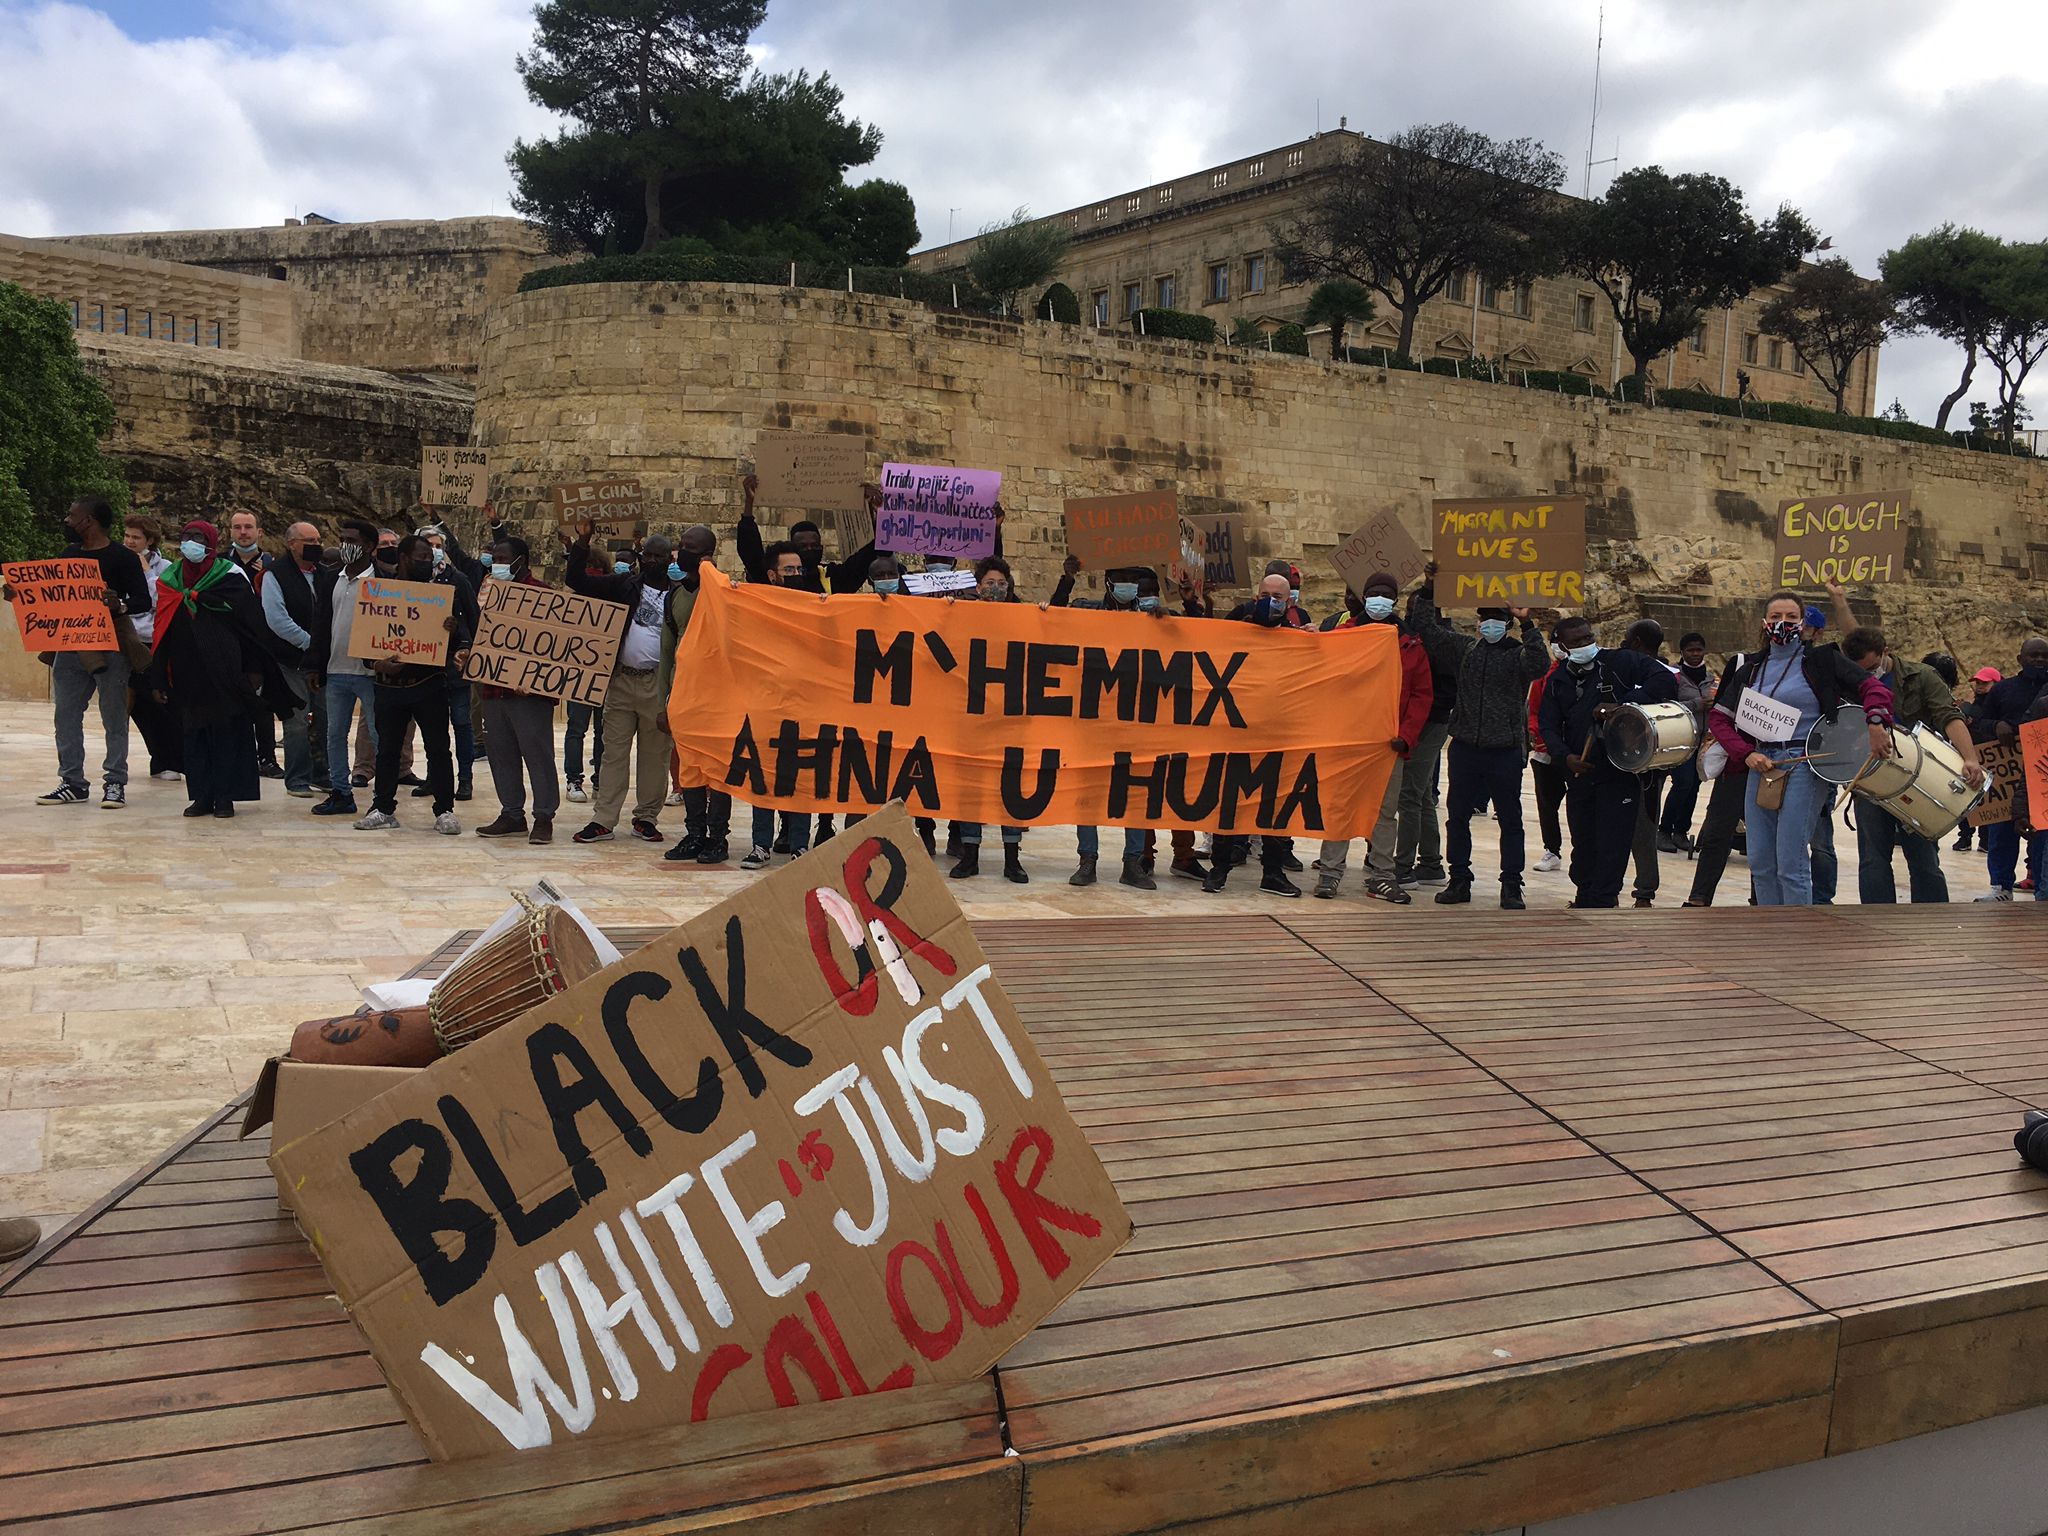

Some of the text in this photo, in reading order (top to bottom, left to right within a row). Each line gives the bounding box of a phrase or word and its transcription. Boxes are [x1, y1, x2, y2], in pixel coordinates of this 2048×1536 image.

[560, 486, 596, 504] LE
[950, 476, 974, 501] fejn
[1440, 505, 1554, 535] MIGRANT
[1783, 500, 1900, 537] ENOUGH
[1334, 518, 1393, 570] ENOUGH
[1456, 537, 1538, 563] LIVES
[1829, 534, 1850, 553] IS
[8, 562, 101, 584] SEEKING ASYLUM
[1366, 550, 1391, 572] IS
[1781, 553, 1893, 586] ENOUGH
[17, 588, 36, 605] IS
[41, 585, 66, 603] NOT
[68, 585, 77, 602] A
[1456, 571, 1585, 604] MATTER
[359, 601, 420, 621] THERE IS
[484, 583, 626, 633] DIFFERENT
[25, 612, 60, 638] Being
[61, 613, 94, 629] racist
[387, 622, 406, 638] NO
[489, 623, 600, 667] COLOURS
[465, 652, 610, 706] ONE PEOPLE
[1741, 710, 1774, 732] MATTER
[1744, 698, 1796, 727] BLACK LIVES
[1000, 747, 1060, 821] U
[1108, 750, 1325, 831] HUMA
[1978, 807, 1999, 822] HOW
[349, 836, 957, 1307] BLACK OR
[421, 1130, 811, 1450] WHITE
[795, 964, 1034, 1247] JUST
